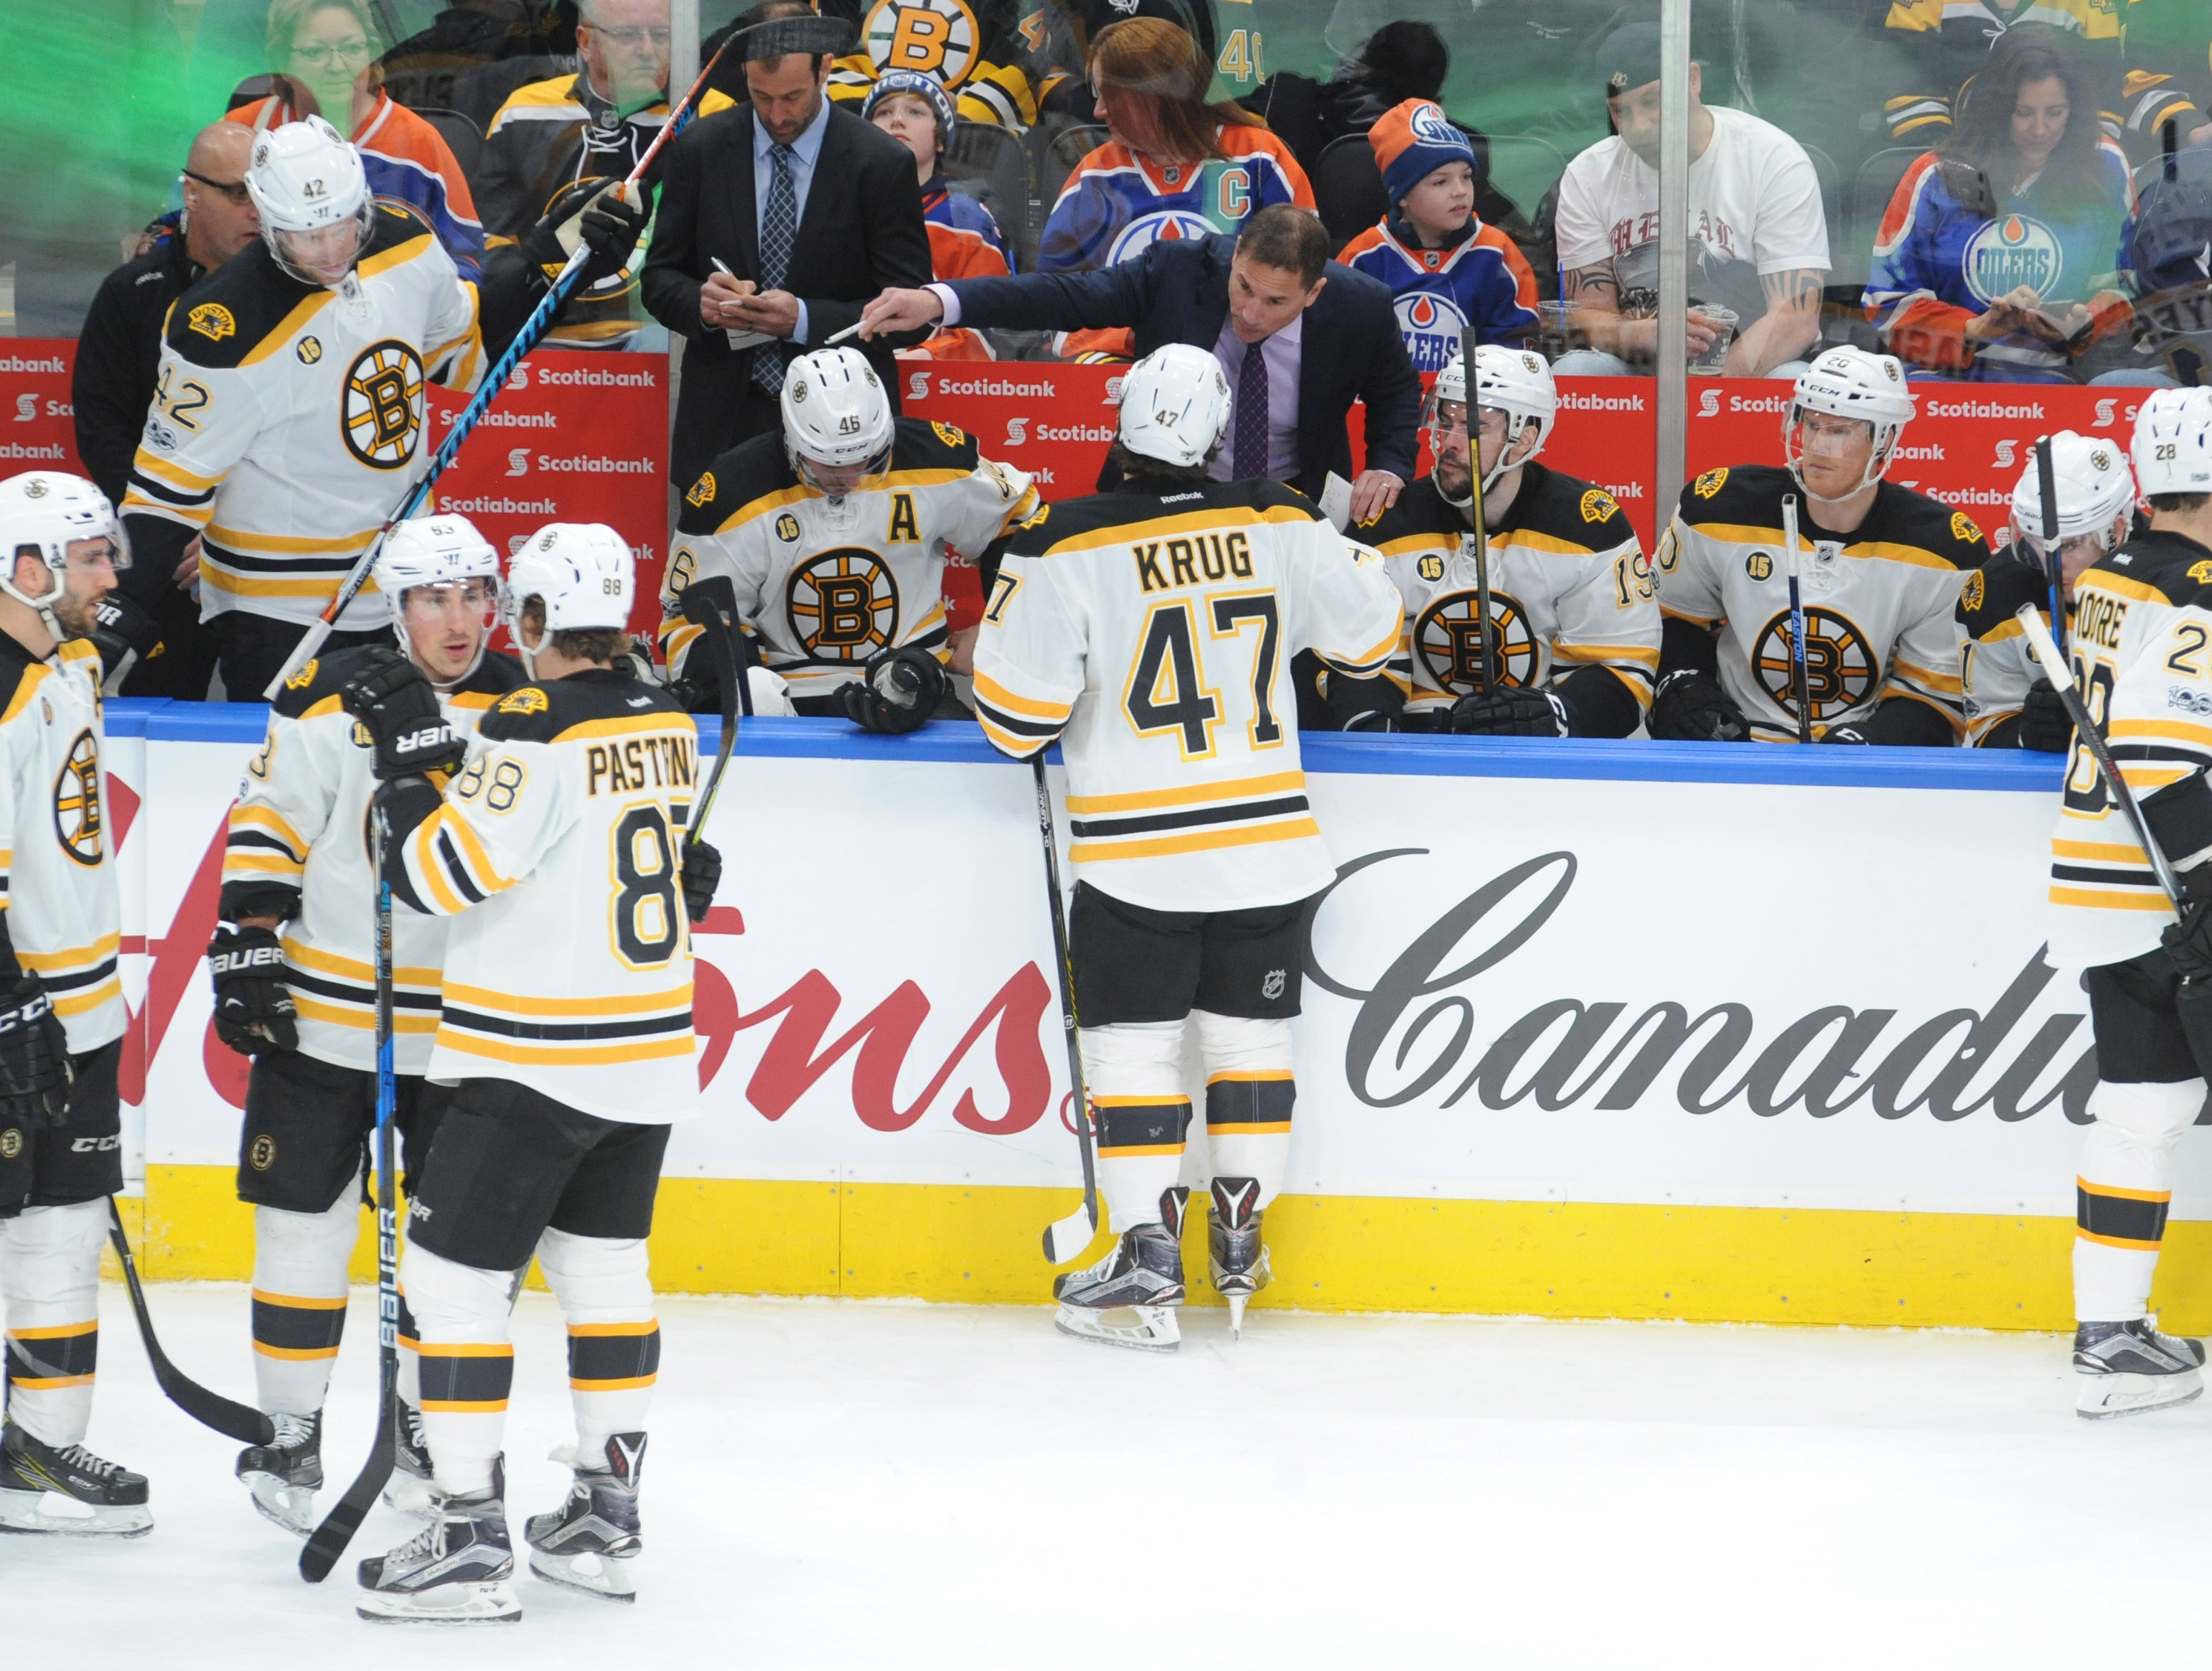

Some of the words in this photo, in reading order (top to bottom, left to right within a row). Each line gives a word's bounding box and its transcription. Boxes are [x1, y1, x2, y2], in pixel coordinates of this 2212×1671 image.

[302, 179, 327, 198] 42
[1218, 167, 1251, 220] C
[1977, 248, 2051, 276] OILERS
[299, 337, 321, 362] 15
[1827, 357, 1850, 369] 20
[538, 368, 655, 387] Scotiabank
[154, 362, 213, 434] 42
[939, 378, 1056, 398] Scotiabank
[1809, 384, 1842, 396] CCM
[440, 409, 557, 428] Sctiabank
[1156, 410, 1179, 429] 47
[1926, 400, 2045, 419] Scotiabank
[838, 414, 862, 433] 46
[1036, 424, 1117, 443] Scotiab
[2155, 444, 2176, 461] 28
[538, 455, 655, 474] Scotiabank
[440, 496, 556, 514] Scotiabank
[1160, 491, 1204, 504] Reebok
[887, 491, 922, 543] A
[777, 516, 799, 540] 15
[1132, 530, 1255, 595] KRUG
[1420, 556, 1443, 579] 15
[1748, 555, 1771, 579] 15
[602, 579, 622, 596] 88
[1790, 609, 1804, 663] EASTON
[2162, 619, 2212, 680] 2
[1120, 587, 1285, 763] 47
[609, 798, 693, 972] 8
[380, 1207, 398, 1349] BAUER
